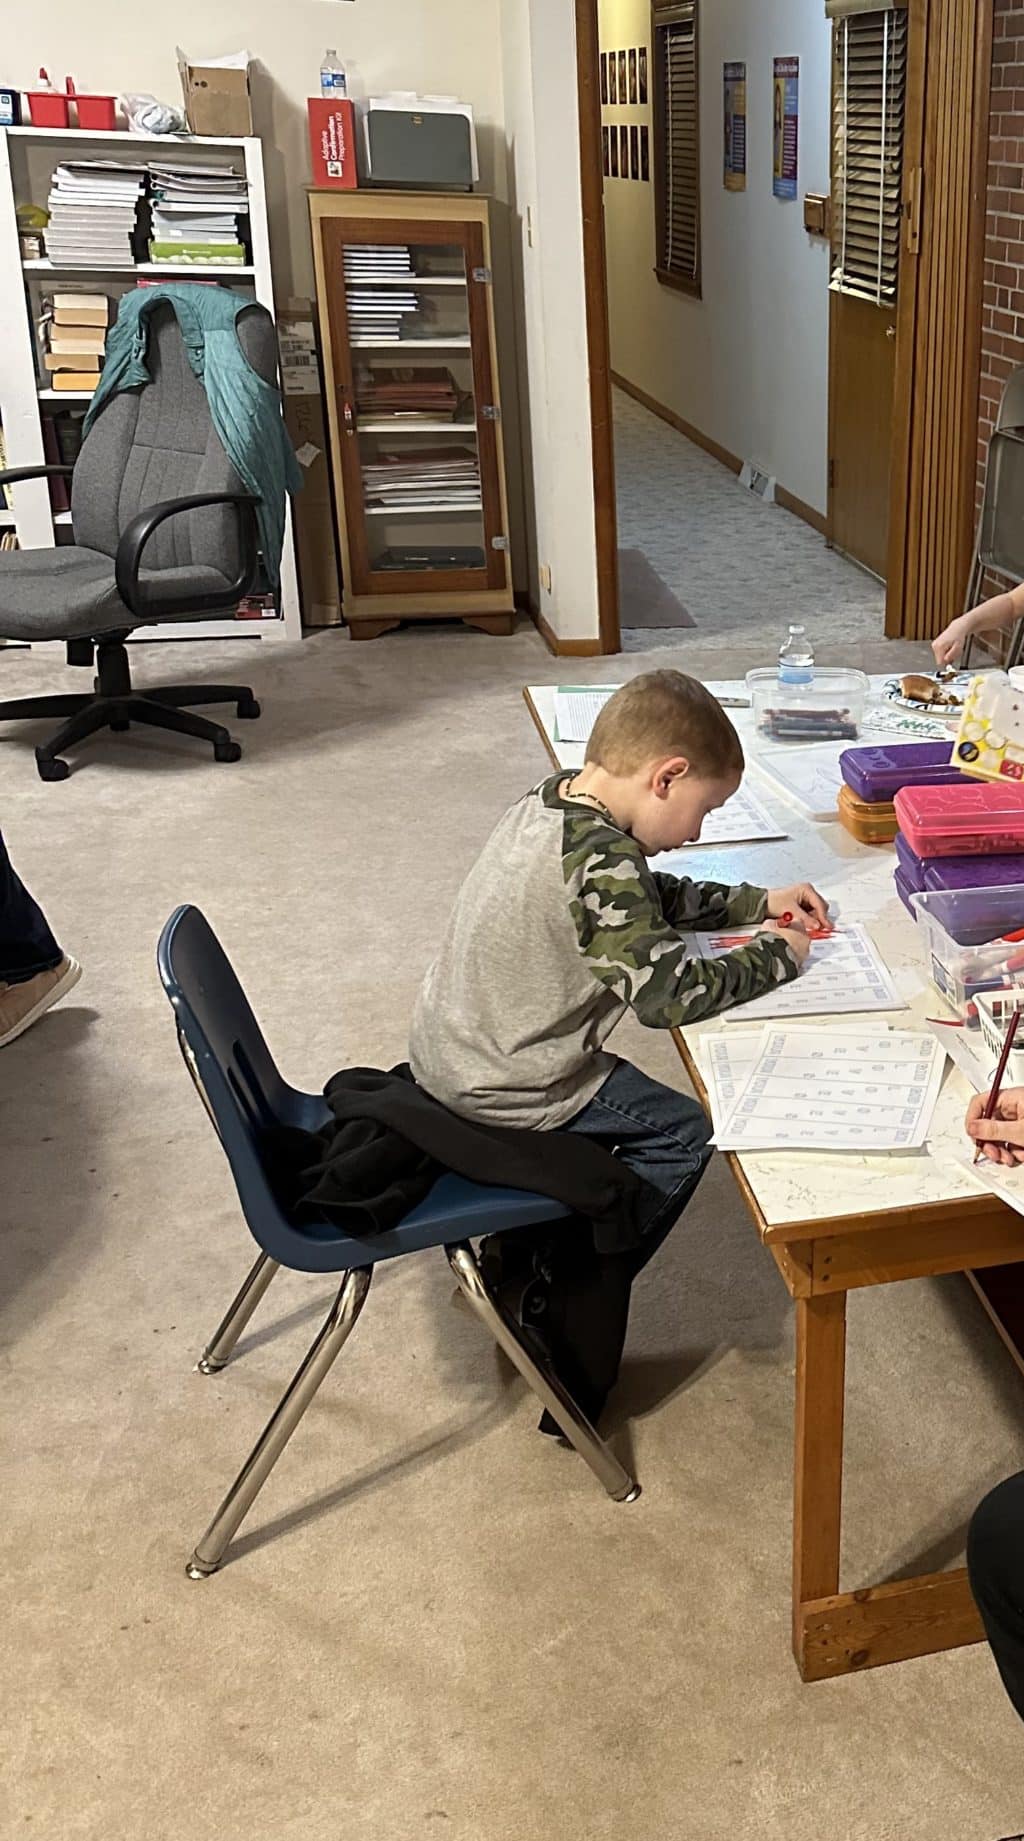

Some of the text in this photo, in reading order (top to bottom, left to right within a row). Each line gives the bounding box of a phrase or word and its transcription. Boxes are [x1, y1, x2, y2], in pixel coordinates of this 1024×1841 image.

[328, 116, 337, 160] Confirmation
[335, 112, 346, 160] Preparation Kit
